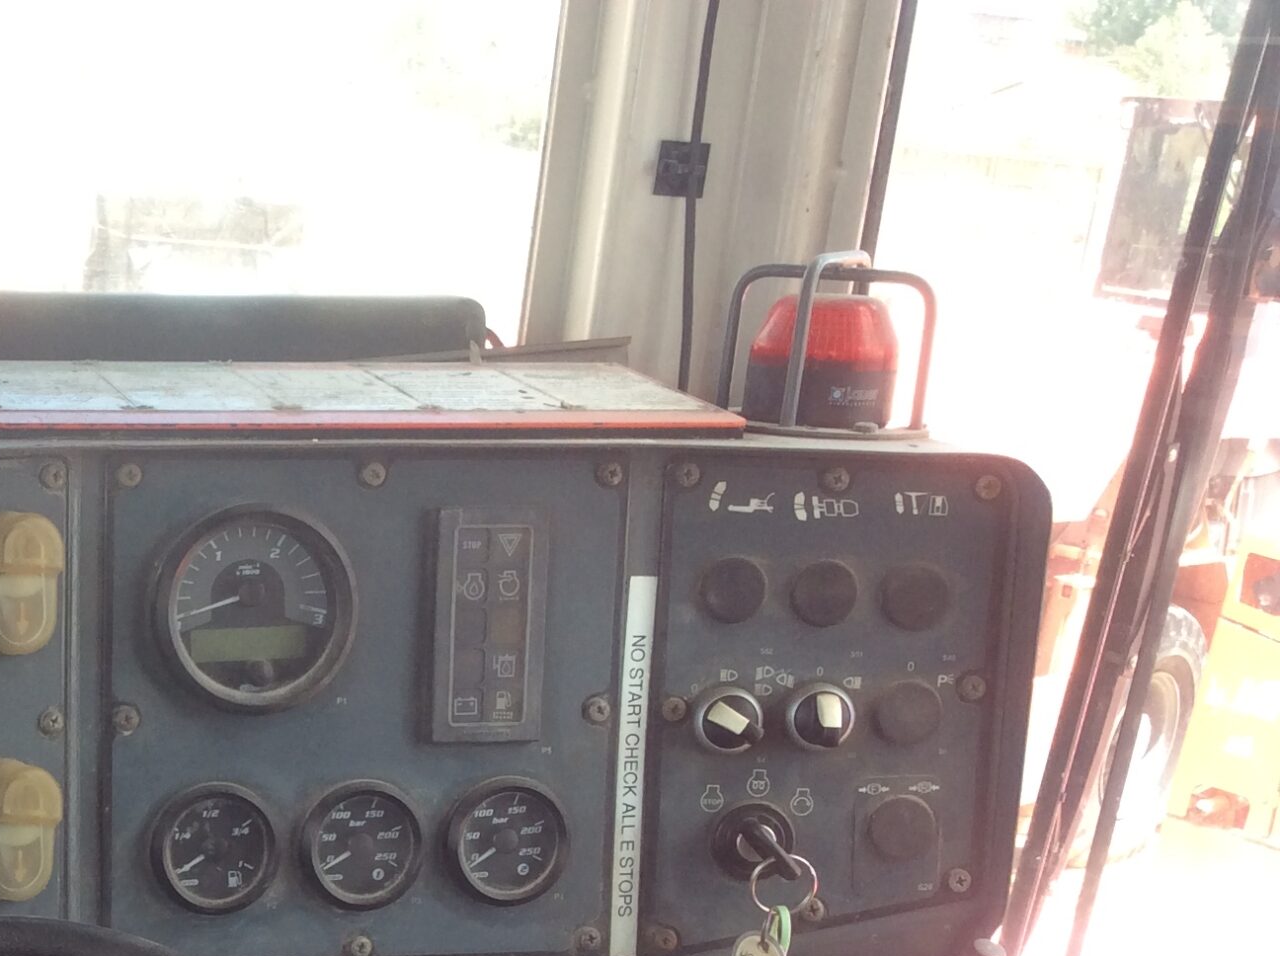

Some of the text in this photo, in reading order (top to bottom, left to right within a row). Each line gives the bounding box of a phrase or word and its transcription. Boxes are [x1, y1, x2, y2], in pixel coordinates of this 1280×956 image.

[462, 541, 481, 549] STOP
[215, 550, 222, 561] 1
[270, 548, 280, 558] 2
[618, 634, 647, 917] NO START CHECK ALL E STOPS
[202, 809, 220, 818] 1/2
[365, 810, 384, 818] 150
[474, 809, 494, 818] 100
[507, 806, 526, 814] 150
[331, 811, 351, 819] 100
[232, 827, 249, 836] 3/4
[520, 826, 542, 834] 200
[175, 832, 191, 840] 1/4
[322, 832, 336, 841] 50
[377, 831, 399, 840] 200
[466, 832, 480, 840] 50
[519, 847, 541, 856] 250
[375, 852, 397, 861] 250
